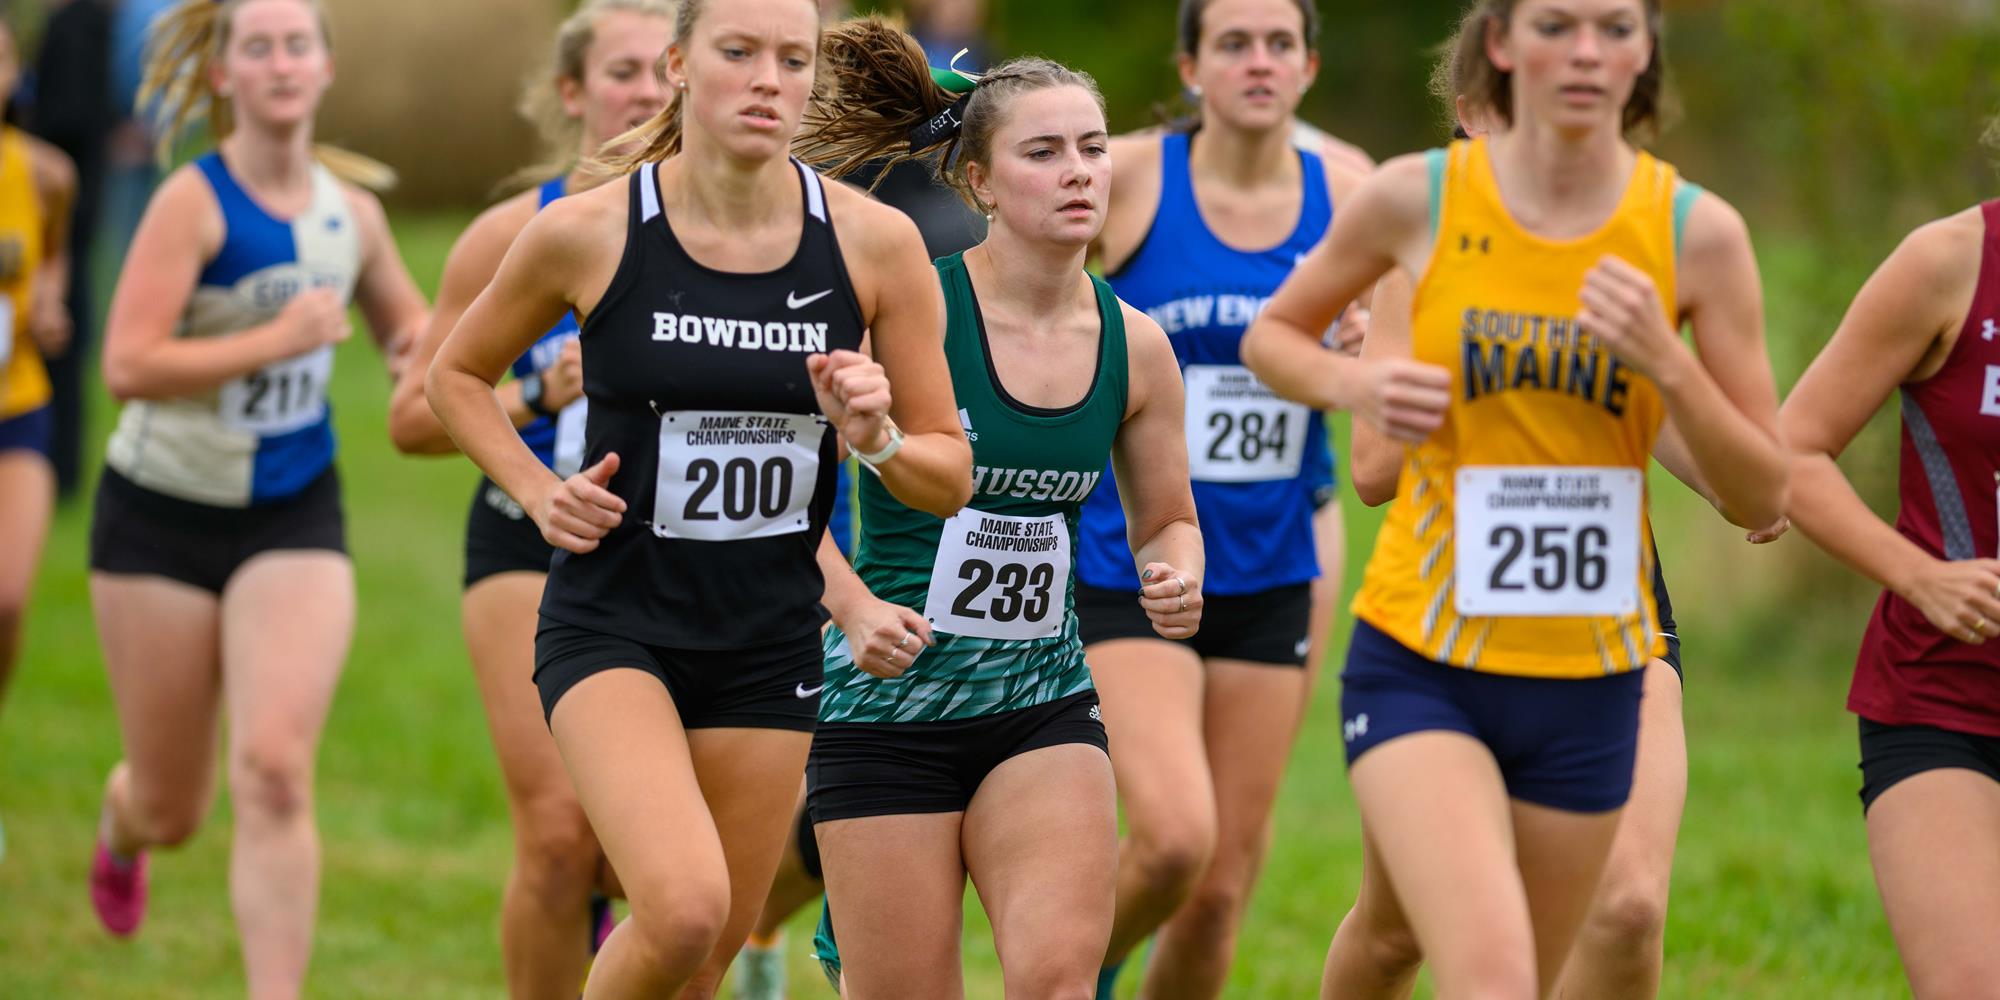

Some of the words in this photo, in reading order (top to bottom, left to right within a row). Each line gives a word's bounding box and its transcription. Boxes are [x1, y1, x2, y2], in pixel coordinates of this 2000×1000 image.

[652, 311, 828, 352] BOWDOIN
[1463, 308, 1602, 350] SOUTHE
[1462, 339, 1630, 419] MAINE
[686, 429, 797, 447] CHAMPIONSHIPS
[699, 416, 742, 430] MAINE
[746, 416, 790, 430] STATE
[1206, 409, 1289, 463] 284
[682, 456, 794, 522] 200
[965, 530, 1059, 553] CHAMPIONSHIPS
[979, 517, 1023, 537] MAINE
[1024, 519, 1054, 537] STATE
[1488, 523, 1609, 594] 256
[950, 558, 1055, 623] 233
